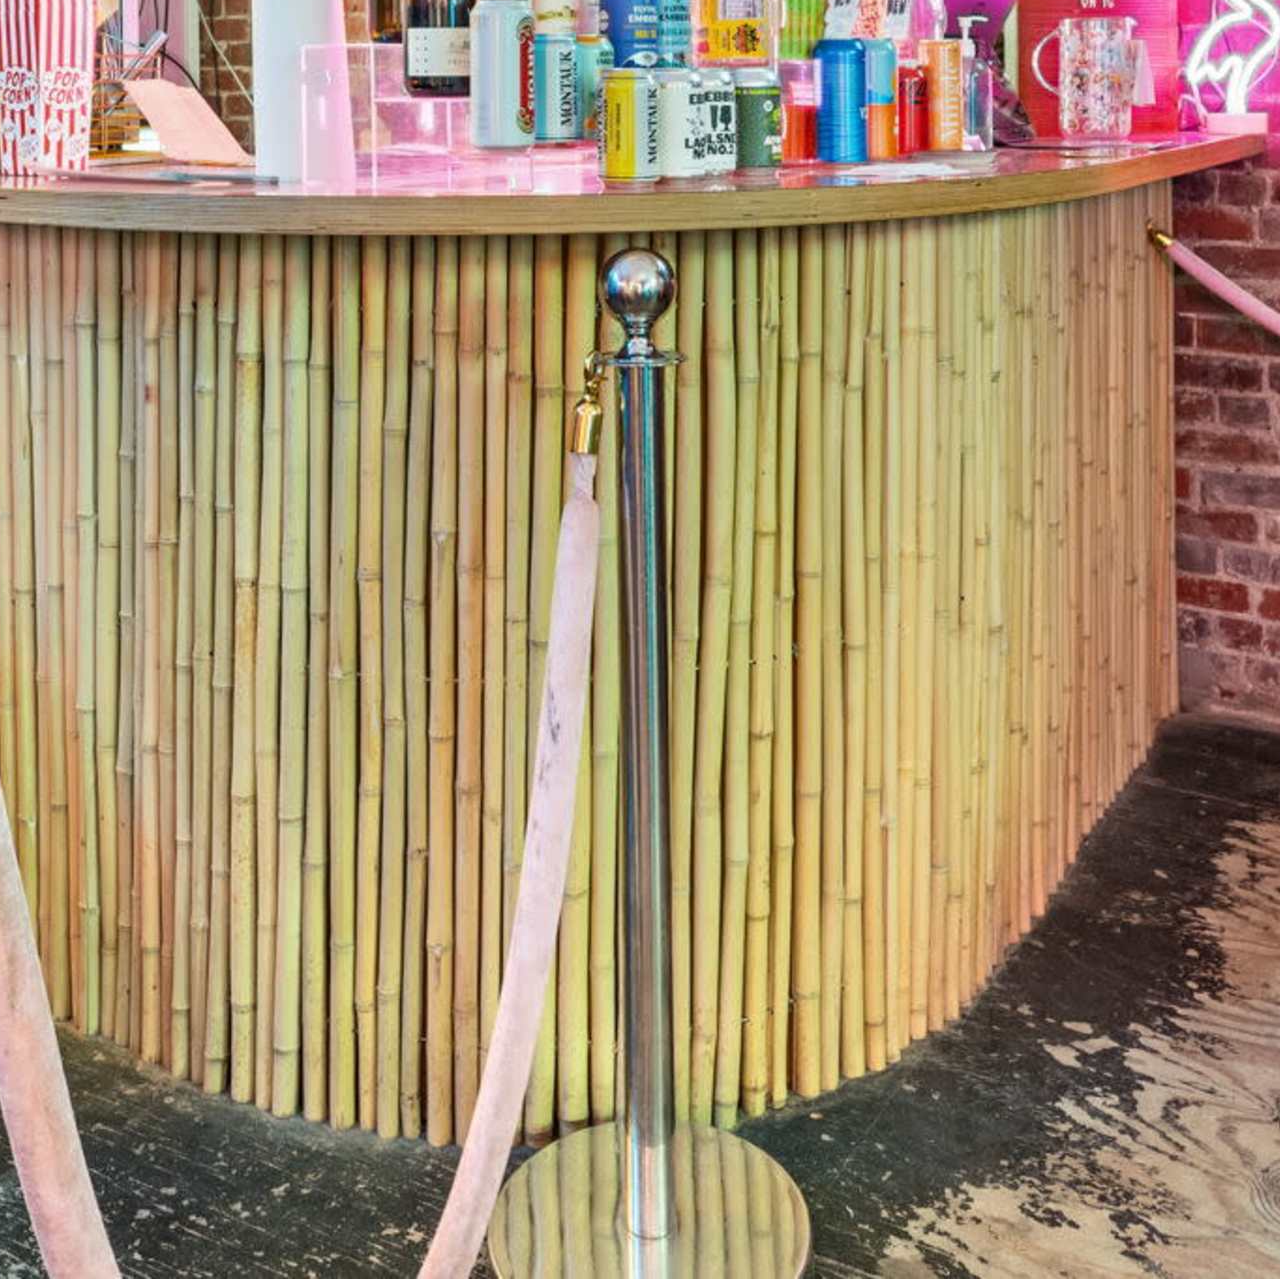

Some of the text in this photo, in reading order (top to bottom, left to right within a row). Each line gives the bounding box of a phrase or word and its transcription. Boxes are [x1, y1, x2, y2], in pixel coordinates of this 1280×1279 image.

[2, 89, 32, 104] CORN
[6, 71, 27, 86] POP
[560, 51, 573, 128] MONTAUK
[648, 87, 658, 164] MONTAUK
